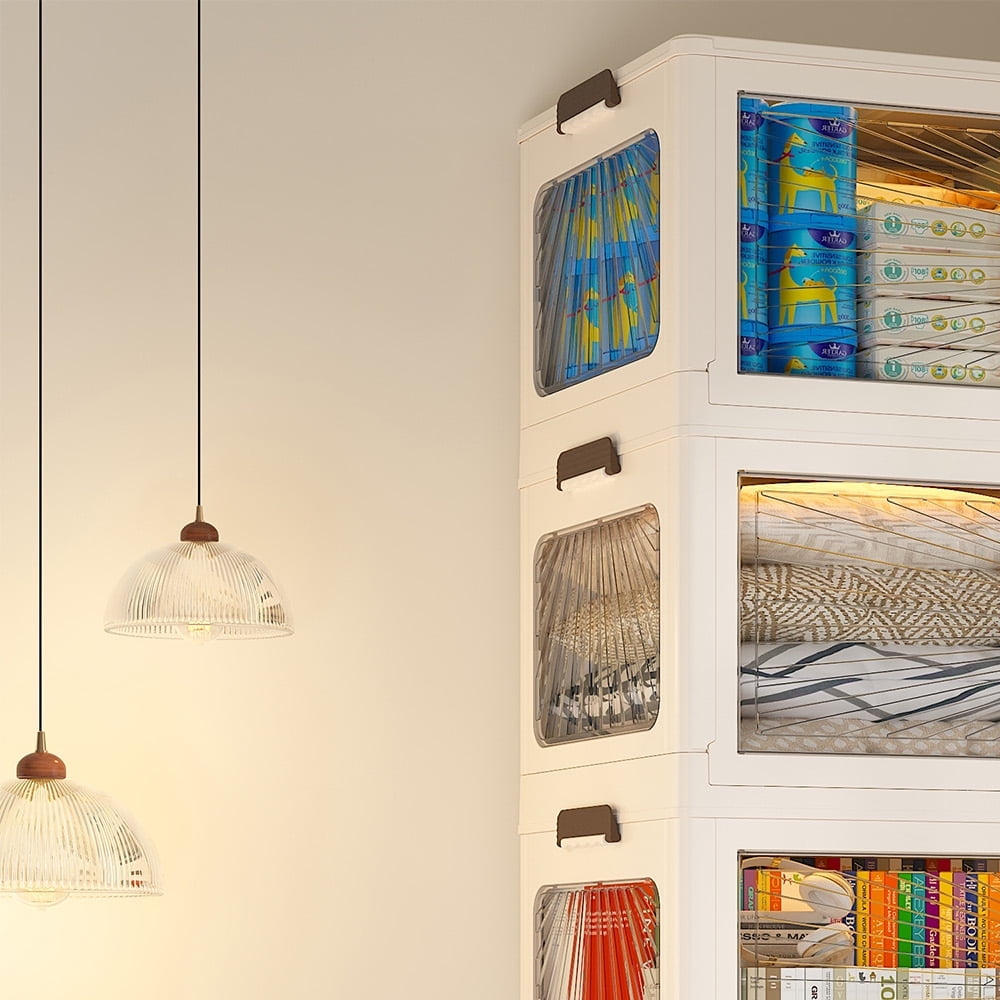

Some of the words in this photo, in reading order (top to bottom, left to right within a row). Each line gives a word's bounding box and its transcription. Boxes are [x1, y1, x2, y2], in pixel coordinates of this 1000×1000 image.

[914, 876, 925, 940] ALEXEY
[929, 930, 938, 967] Gardens
[967, 917, 977, 956] BOOK
